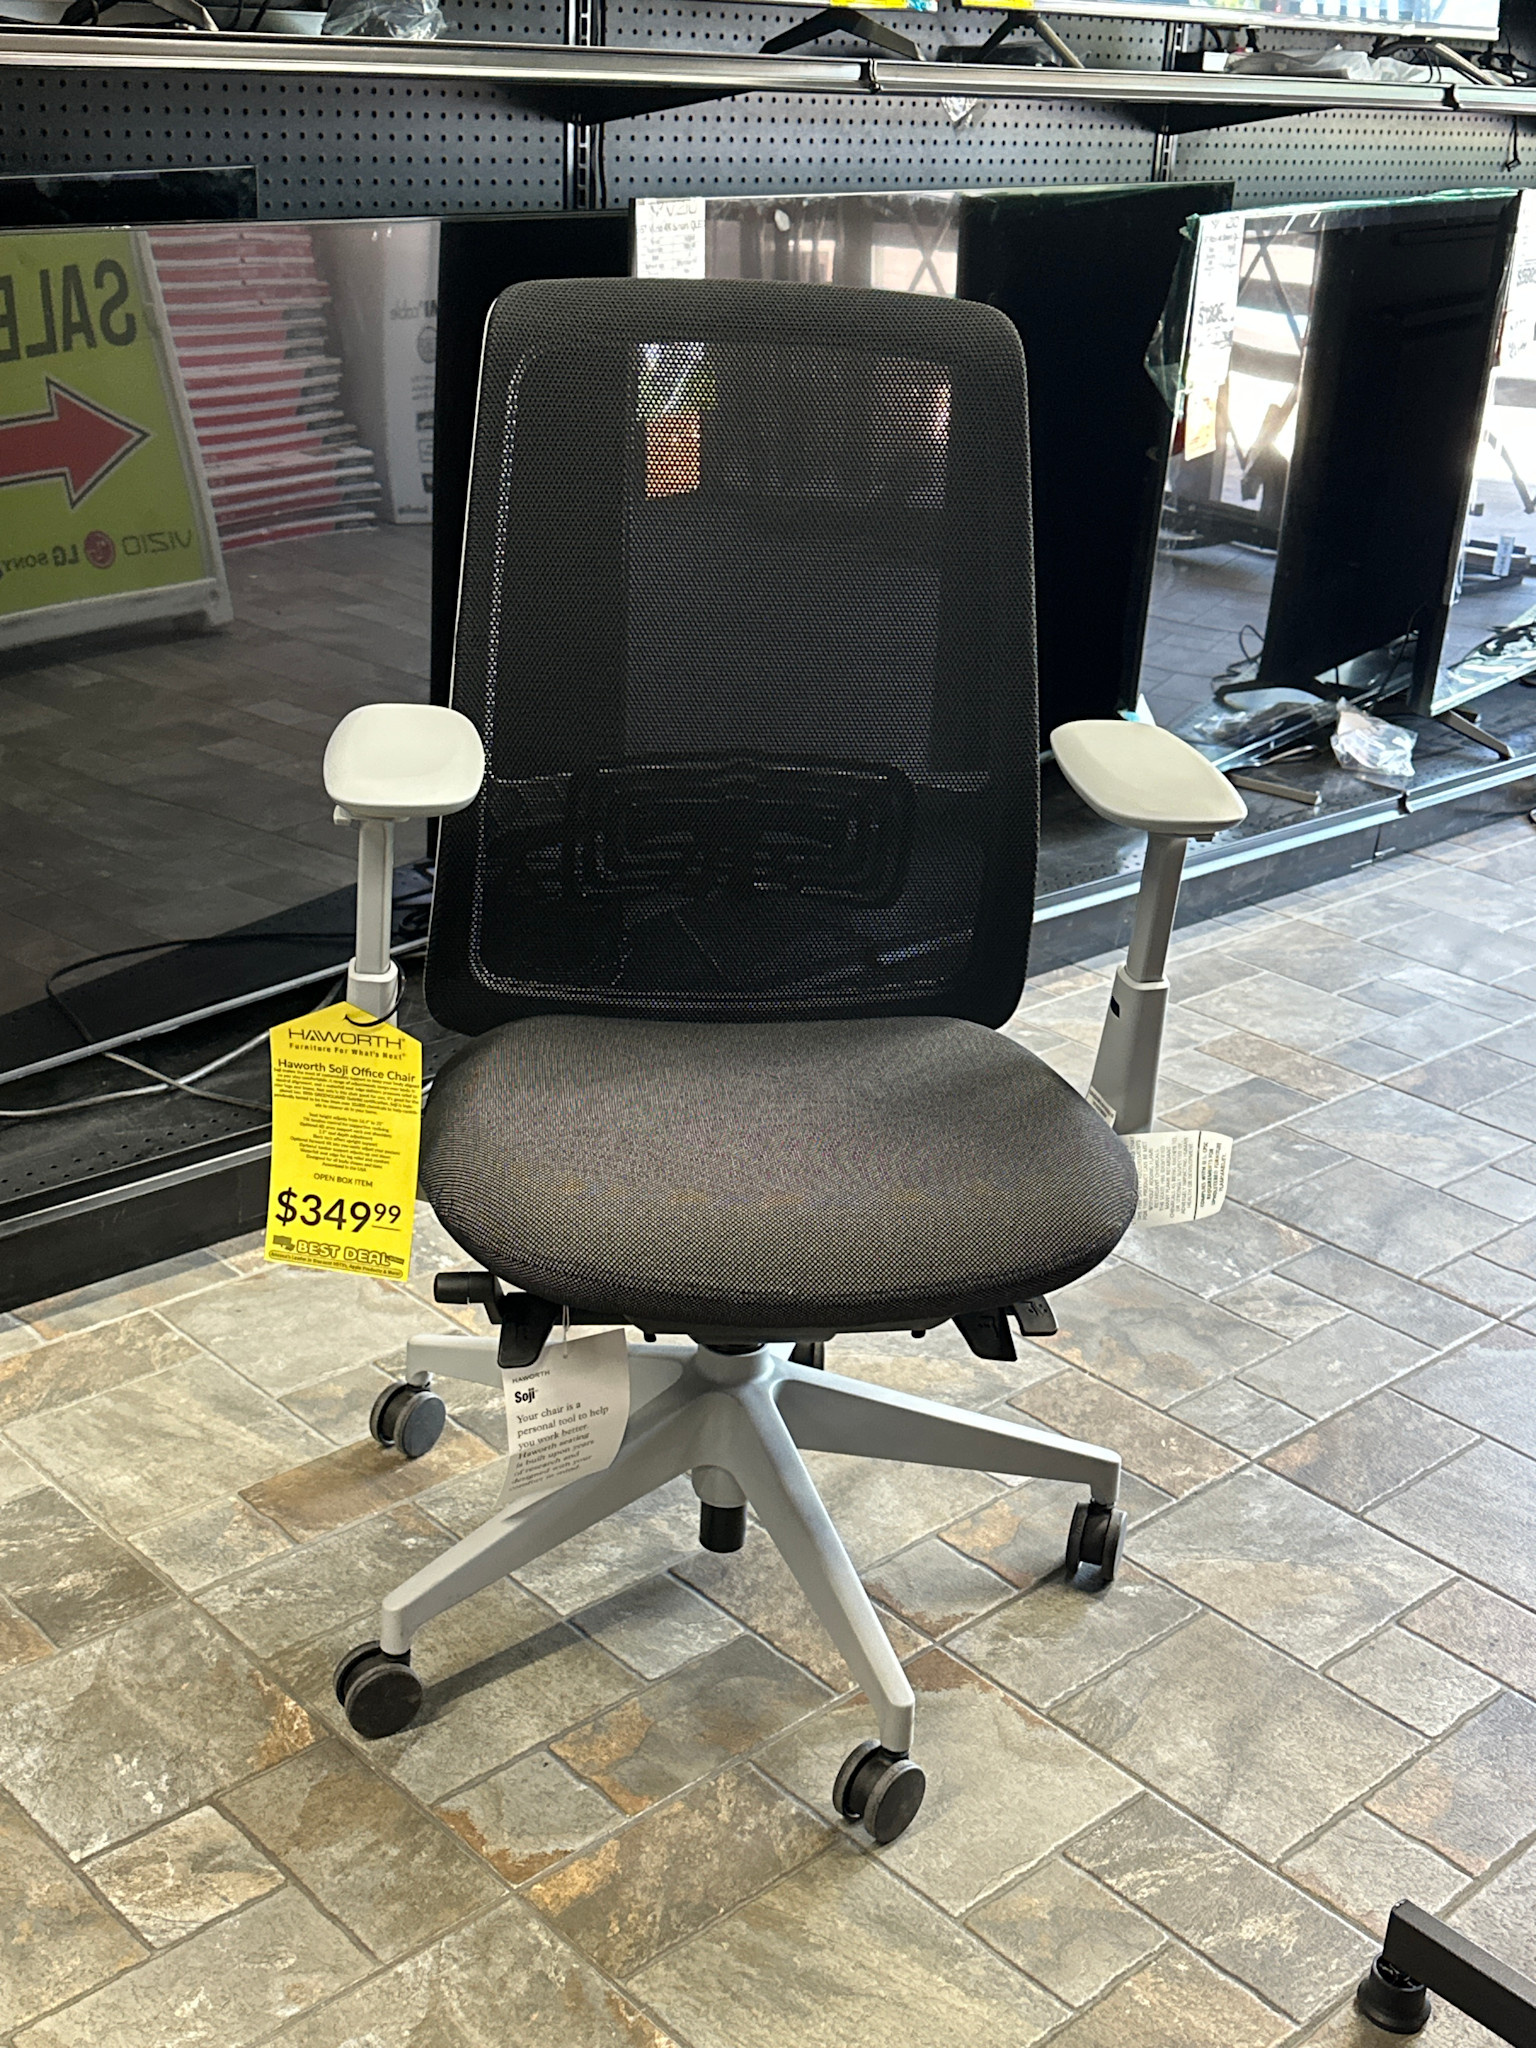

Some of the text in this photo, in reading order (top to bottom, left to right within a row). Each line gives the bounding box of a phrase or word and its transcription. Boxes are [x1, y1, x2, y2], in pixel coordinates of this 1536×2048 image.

[288, 1028, 402, 1050] HAWORTH
[289, 1043, 331, 1053] Furniture
[334, 1046, 348, 1055] For
[351, 1049, 380, 1058] What's
[278, 1058, 416, 1083] Haworth Soji Office Chair
[313, 1172, 373, 1188] OPEN BOX ITEM
[297, 1239, 340, 1258] BEST
[344, 1246, 391, 1267] DEAL
[512, 1370, 550, 1383] HAWORTH
[514, 1387, 536, 1403] Soji
[517, 1412, 538, 1424] Your
[541, 1406, 564, 1419] chair
[566, 1402, 574, 1411] is
[517, 1405, 609, 1438] personal tool to help
[518, 1439, 536, 1451] you
[537, 1433, 559, 1444] work
[518, 1432, 590, 1460] Haworth seating
